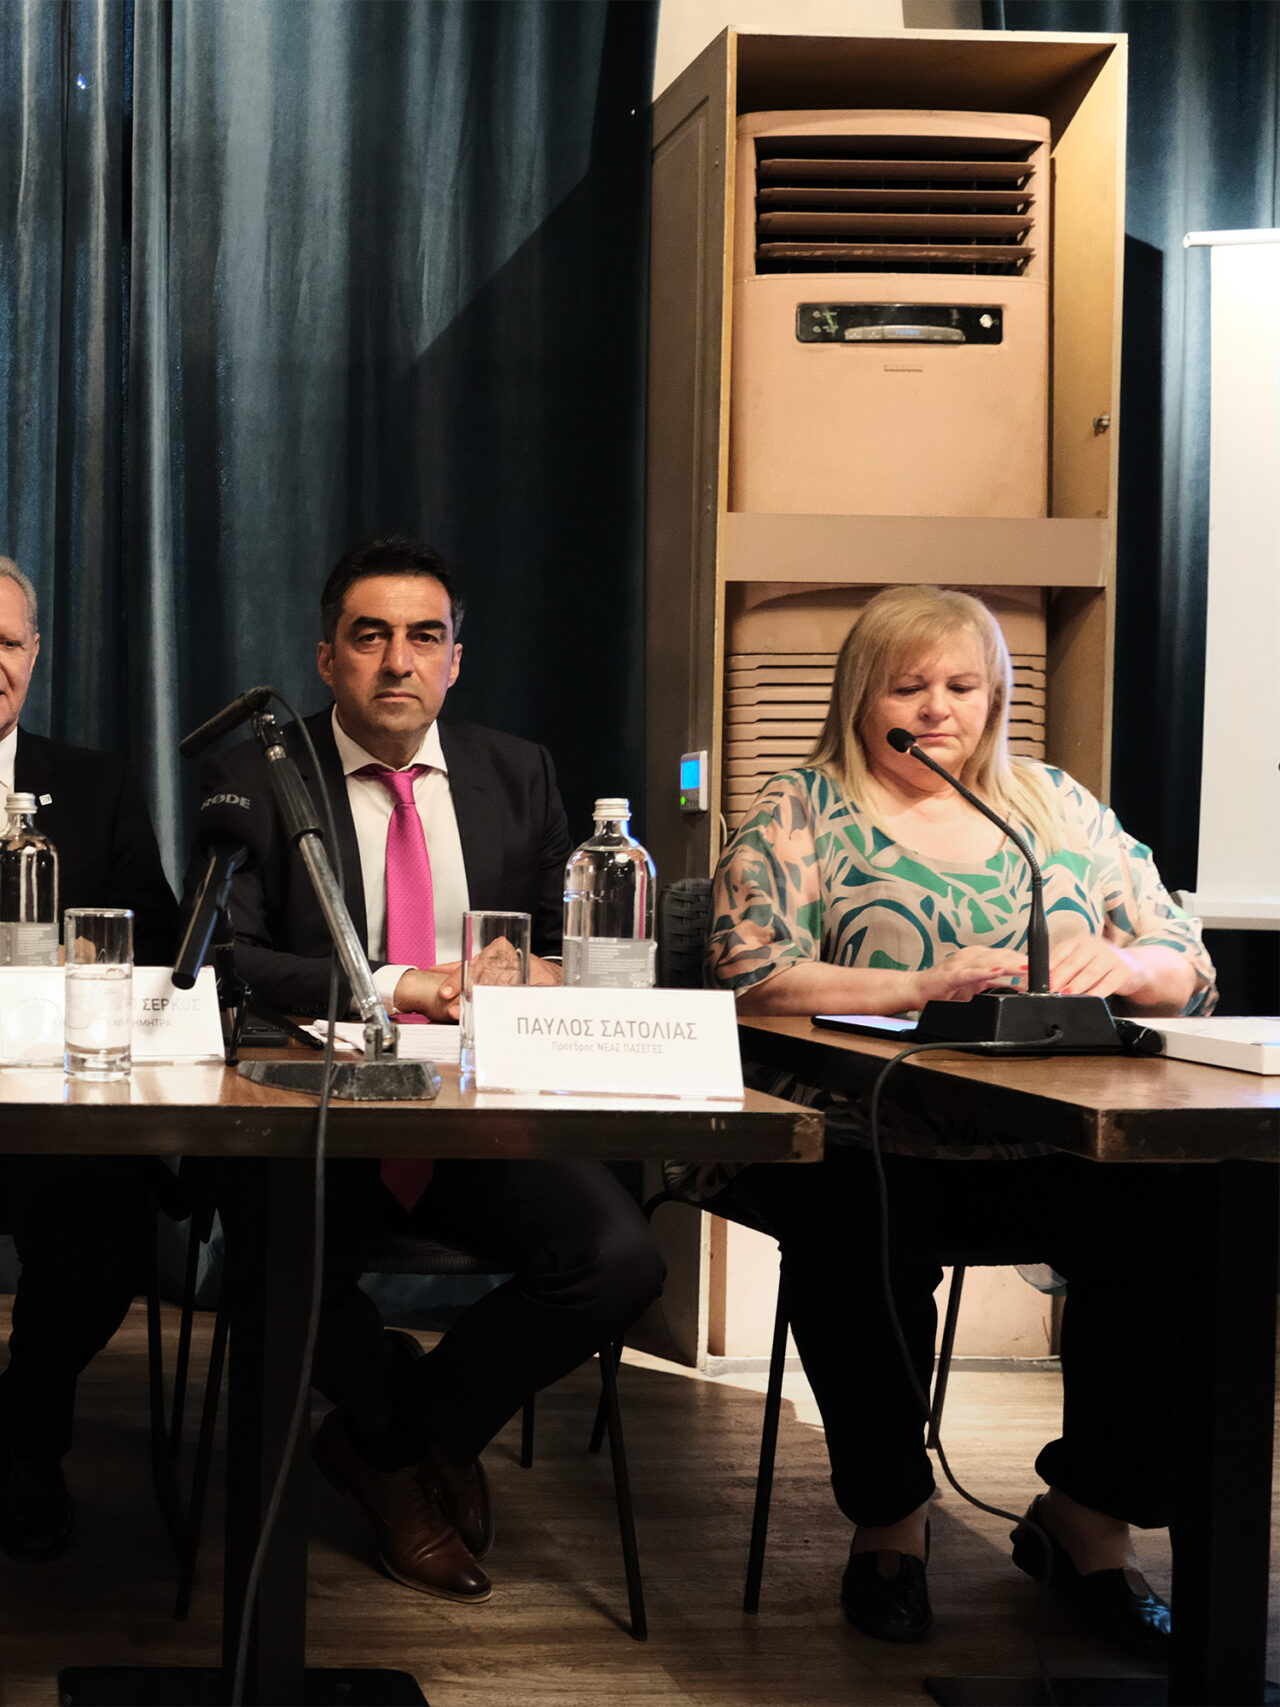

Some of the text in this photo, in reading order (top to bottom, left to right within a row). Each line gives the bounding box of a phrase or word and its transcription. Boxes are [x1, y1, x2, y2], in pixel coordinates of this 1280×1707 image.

[142, 998, 201, 1012] ΣΕΡΚΟΣ
[516, 1016, 698, 1040] ΠΑΥΛΟΣ ΣΑΤΟΛΙΑΣ
